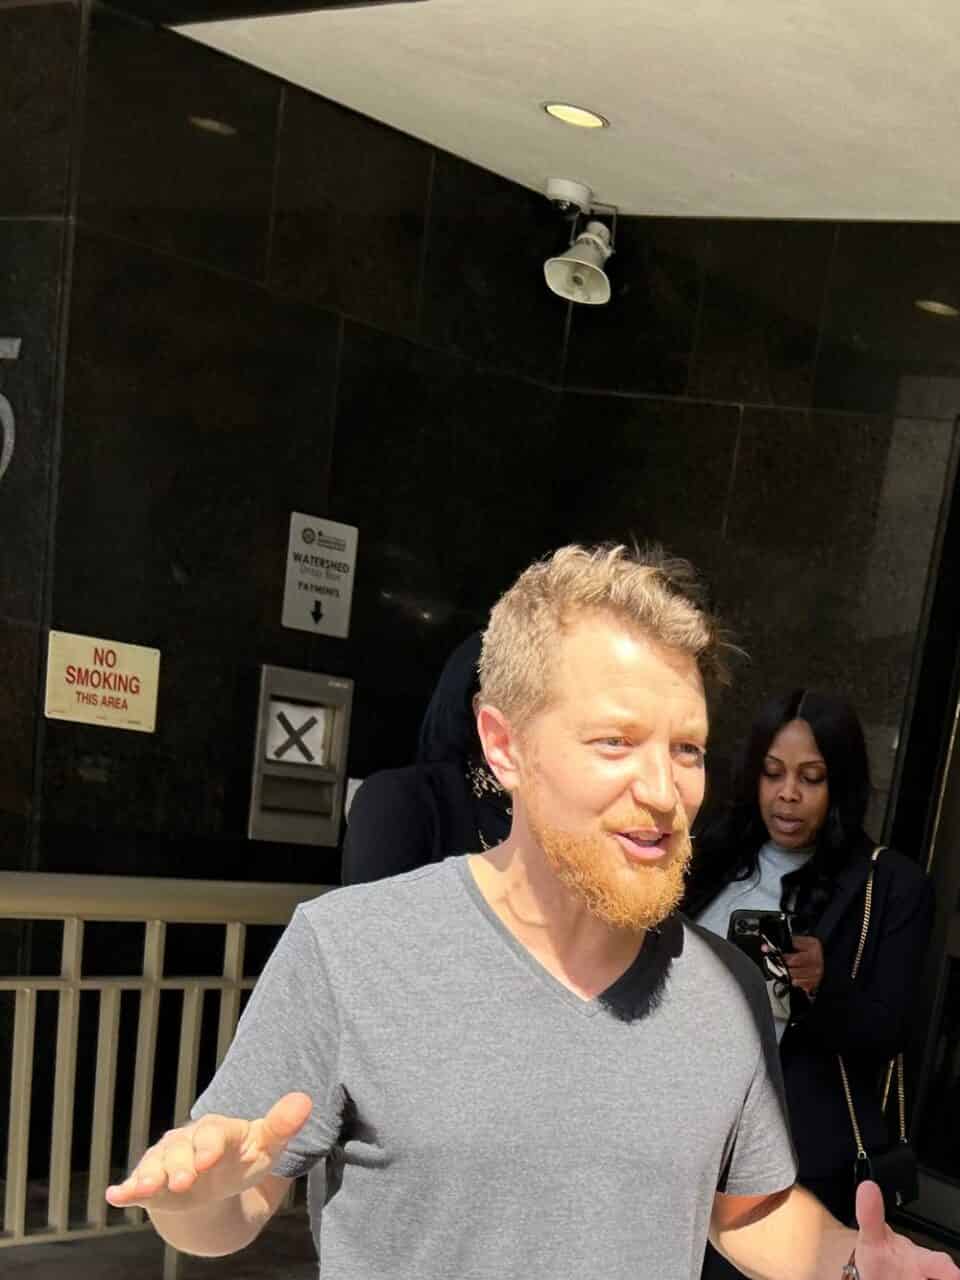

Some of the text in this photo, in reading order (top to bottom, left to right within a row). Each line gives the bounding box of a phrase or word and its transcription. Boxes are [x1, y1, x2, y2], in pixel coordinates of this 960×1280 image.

[292, 551, 350, 574] WATERSHED
[298, 581, 340, 598] PAYMENTS
[94, 647, 117, 668] NO
[65, 665, 140, 694] SMOKING
[75, 691, 129, 711] THIS AREA
